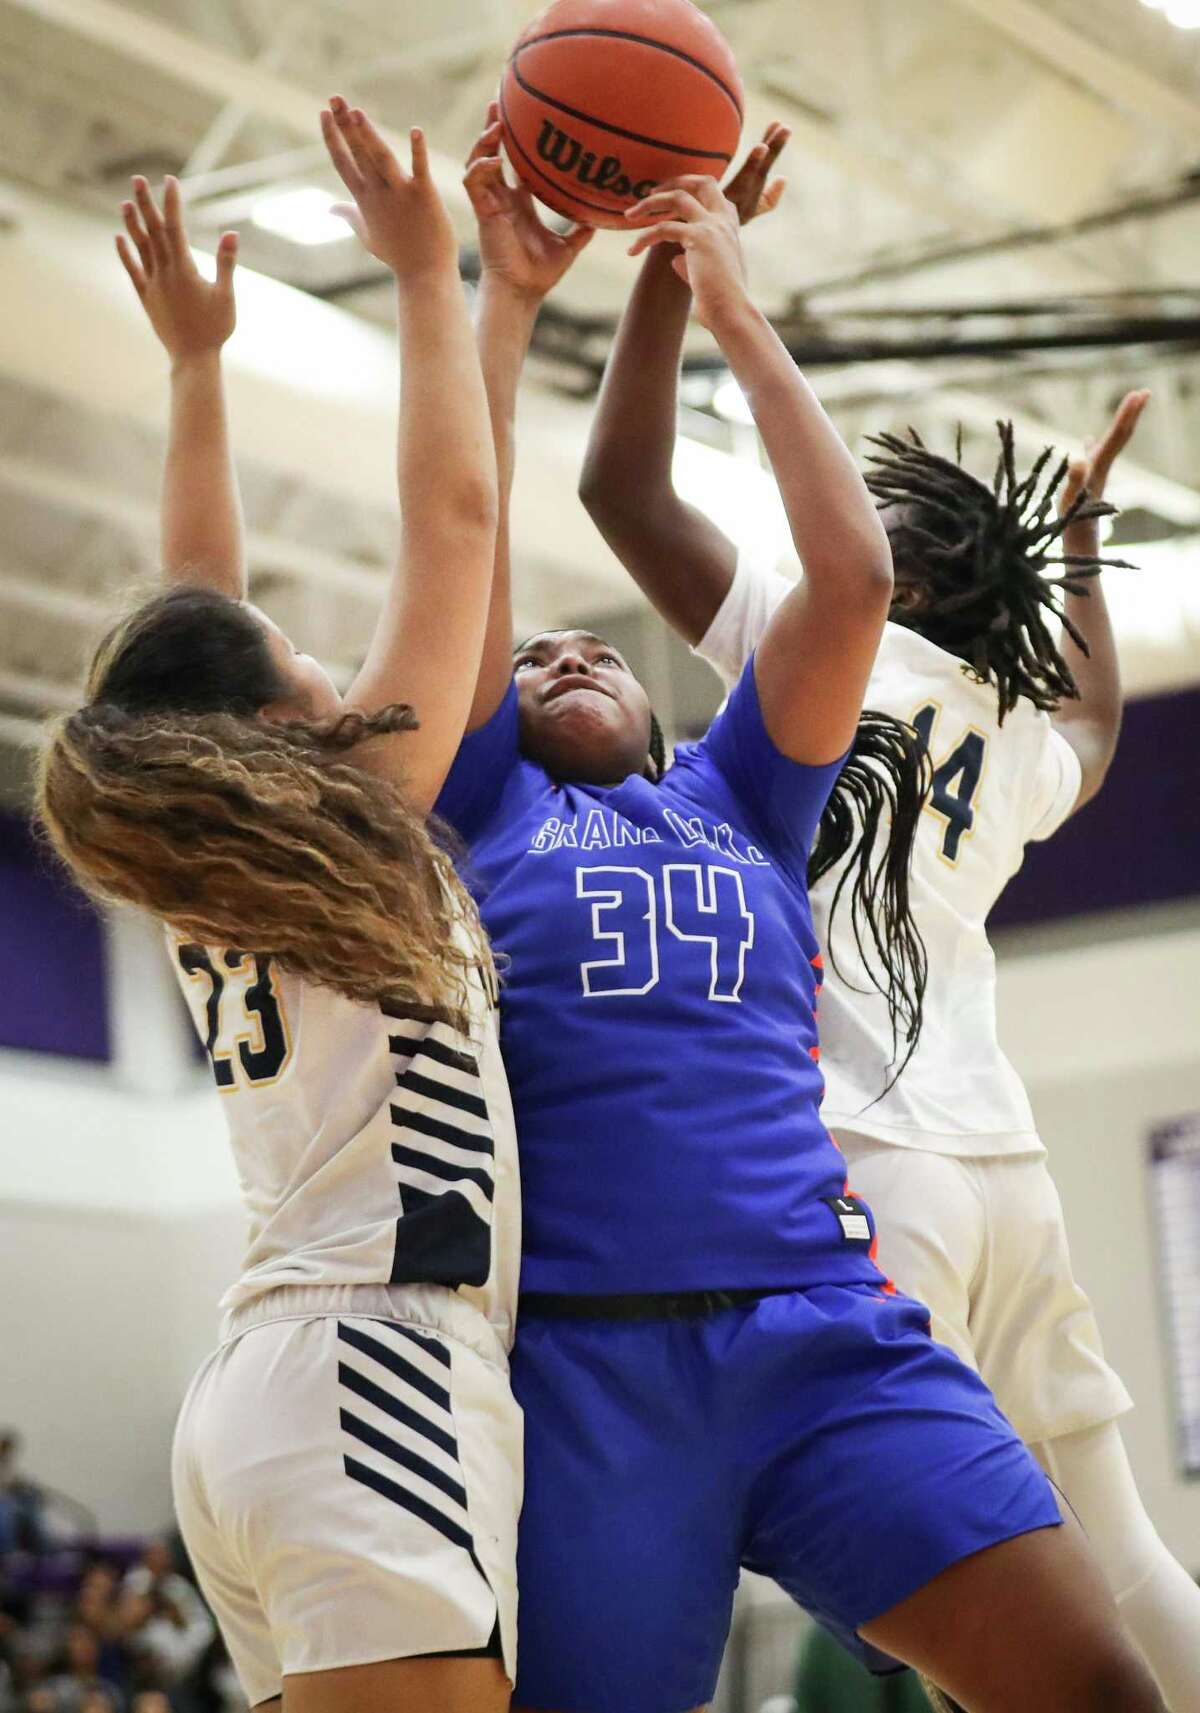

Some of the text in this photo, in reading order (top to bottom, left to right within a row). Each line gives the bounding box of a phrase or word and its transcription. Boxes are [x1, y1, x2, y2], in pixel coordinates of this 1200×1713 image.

[536, 118, 658, 200] Wilso
[900, 698, 990, 870] 14
[575, 863, 755, 1003] 34
[175, 934, 293, 1094] 23
